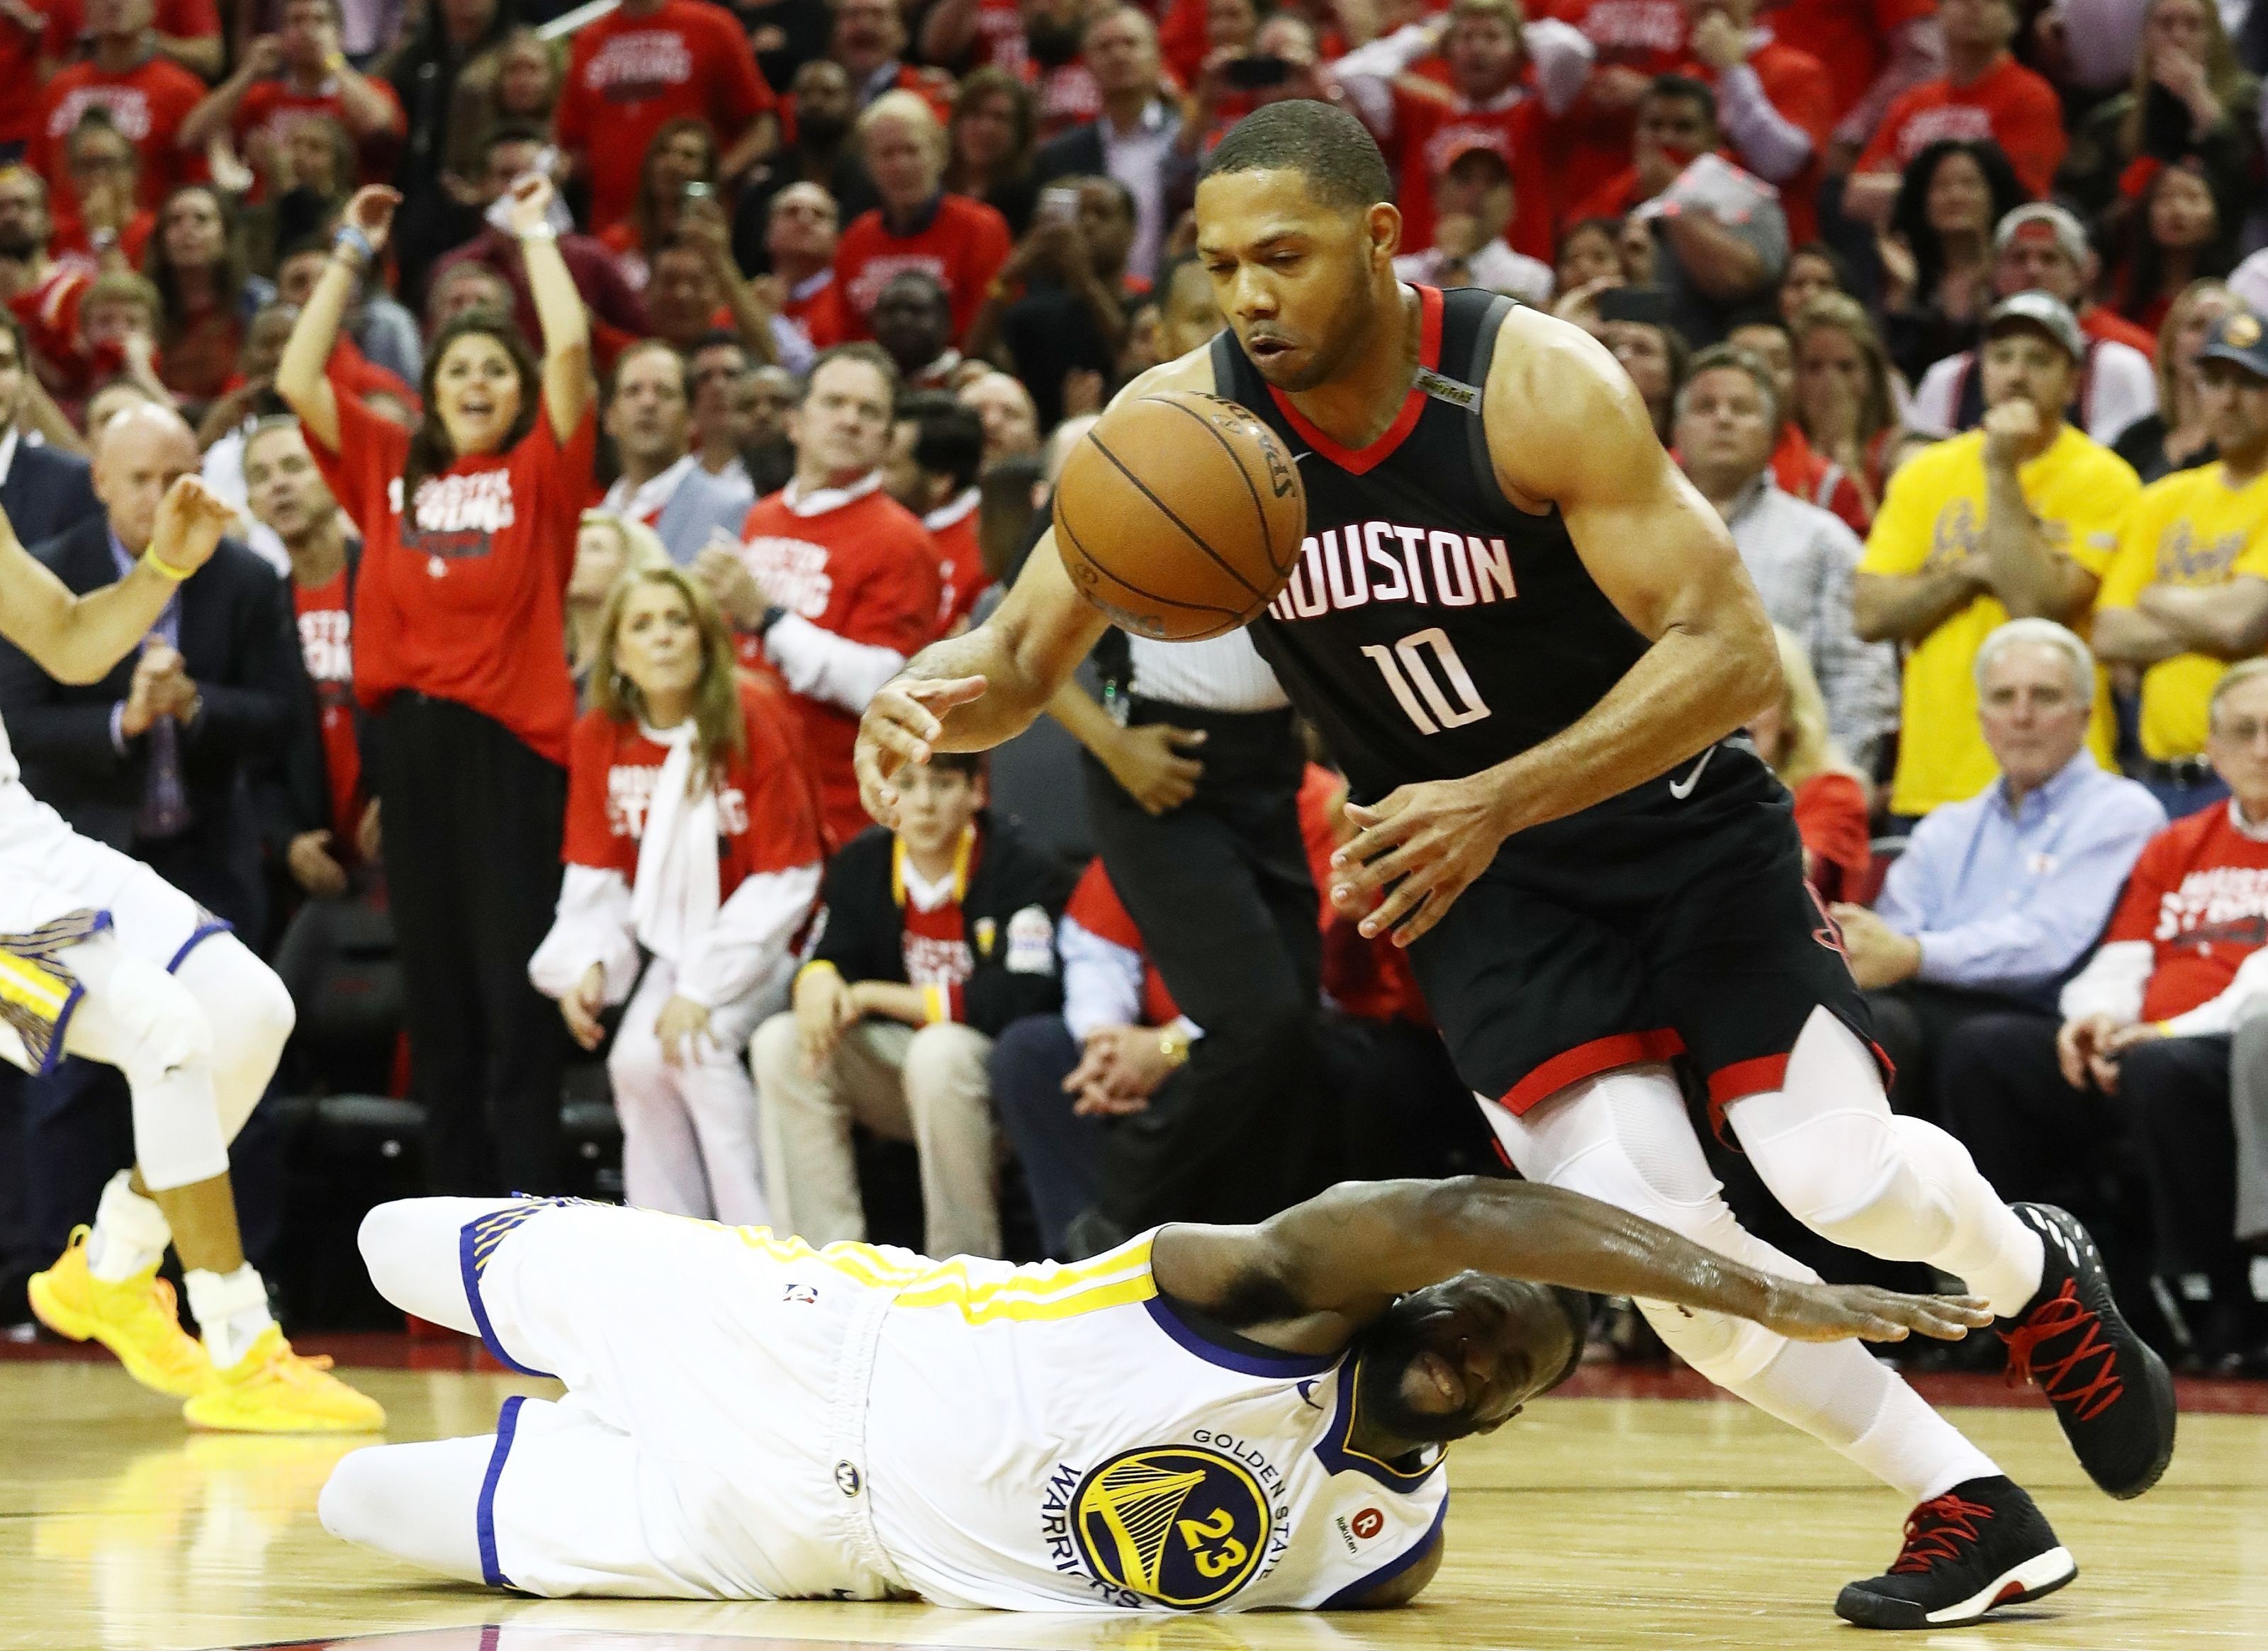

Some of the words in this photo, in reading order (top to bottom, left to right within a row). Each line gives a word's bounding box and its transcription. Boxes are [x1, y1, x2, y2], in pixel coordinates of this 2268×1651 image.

[1360, 628, 1492, 735] 10
[1193, 1429, 1286, 1499] GOLDEN
[1176, 1507, 1248, 1578] 23
